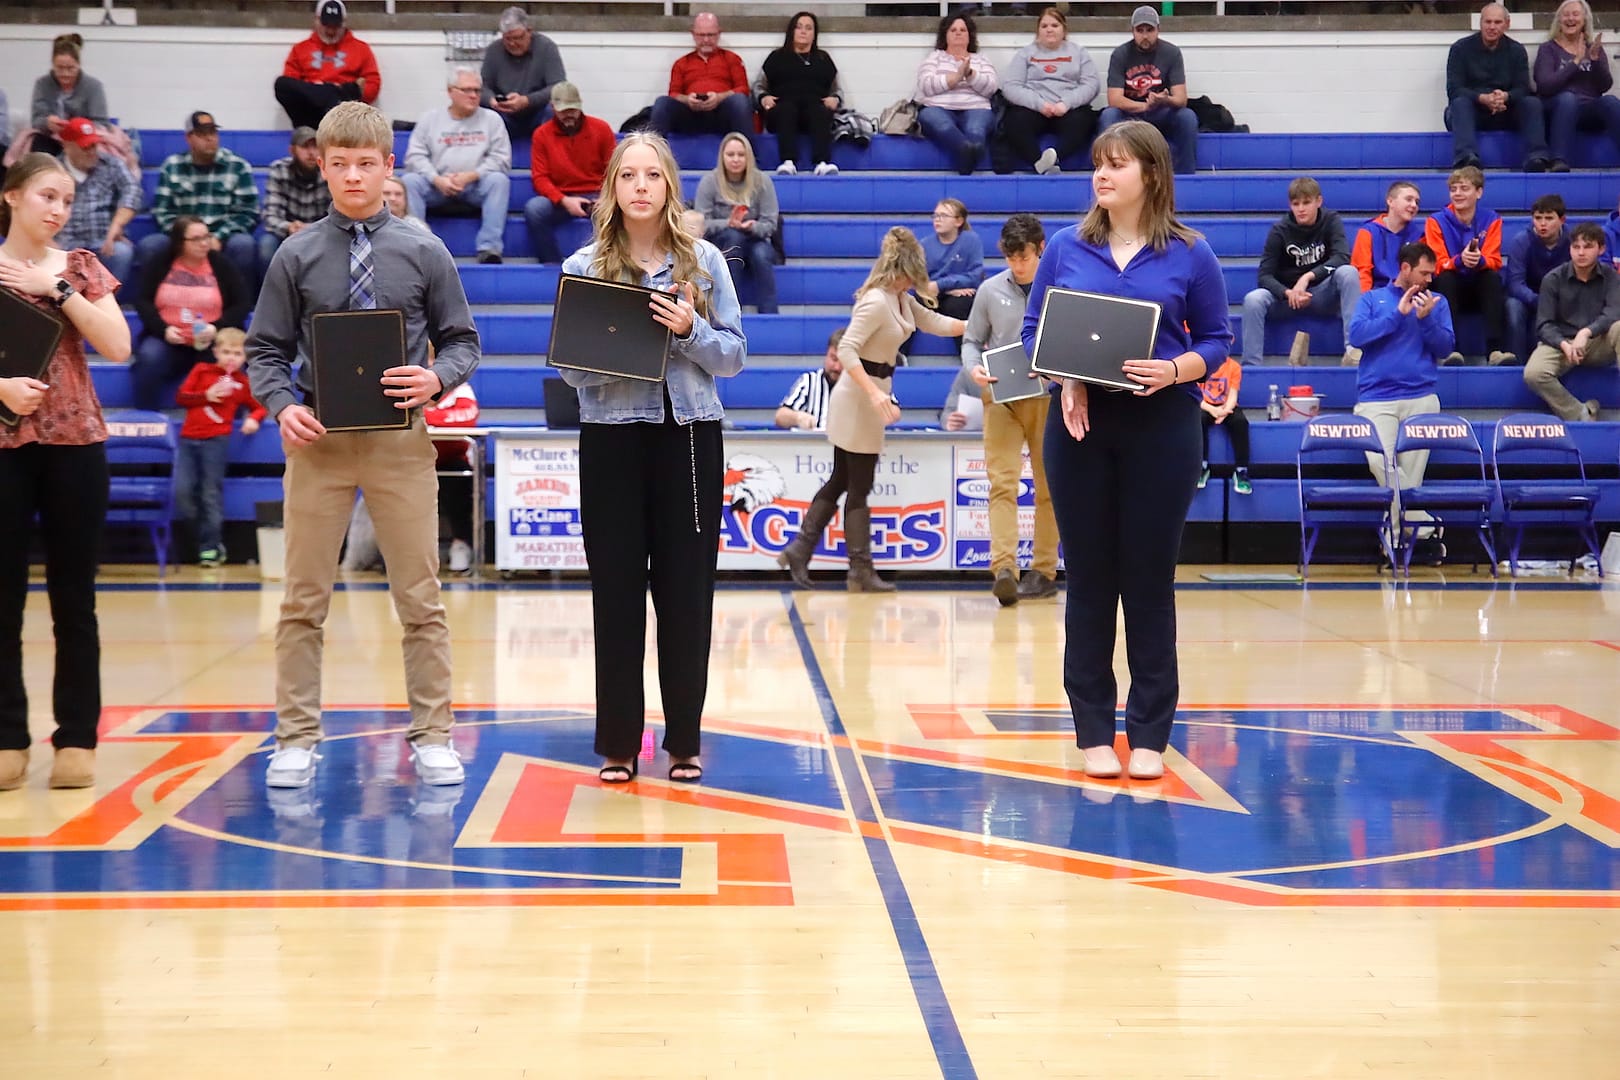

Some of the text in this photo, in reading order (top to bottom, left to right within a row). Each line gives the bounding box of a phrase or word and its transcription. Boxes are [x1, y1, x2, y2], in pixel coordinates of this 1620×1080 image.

[1309, 424, 1371, 438] NEWTON
[1405, 425, 1468, 439] NEWTON
[1503, 424, 1566, 438] NEWTON
[512, 448, 568, 461] McClure
[891, 454, 920, 475] the
[515, 478, 571, 497] JAMES
[512, 508, 573, 523] McClane
[514, 542, 586, 553] MARATHO
